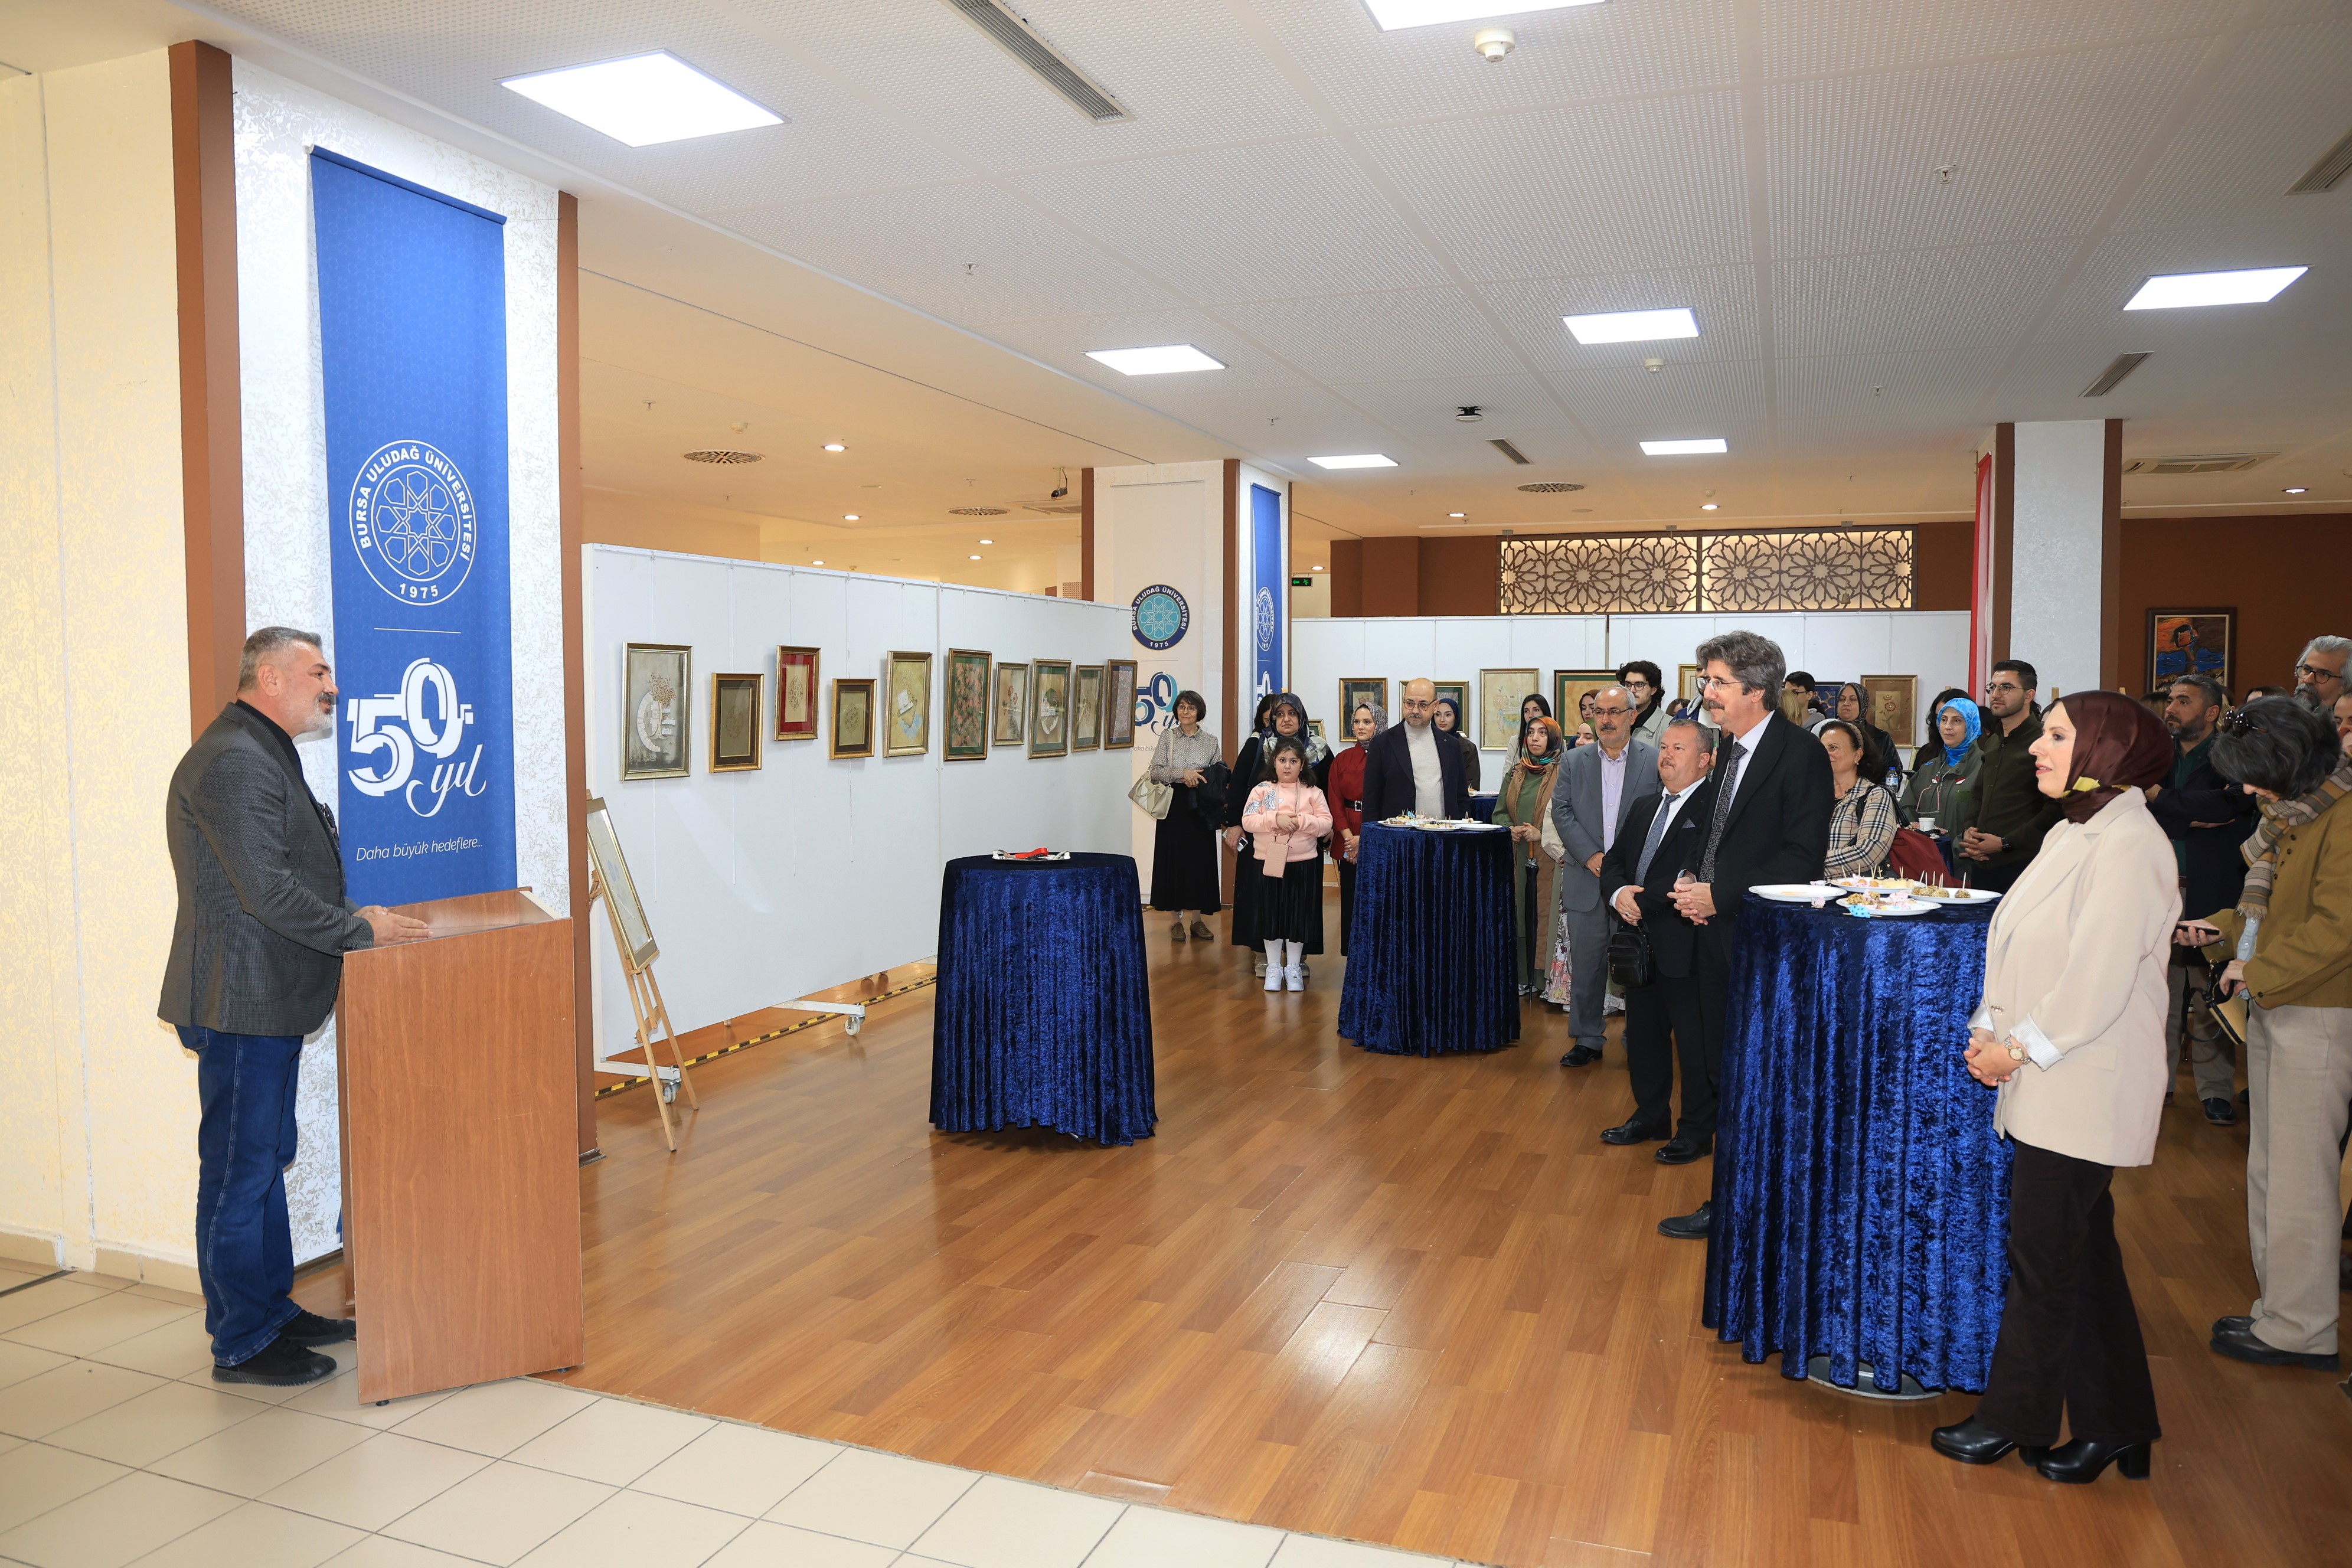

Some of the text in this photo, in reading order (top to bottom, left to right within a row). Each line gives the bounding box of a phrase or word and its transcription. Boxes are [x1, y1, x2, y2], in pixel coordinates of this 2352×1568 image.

[356, 445, 472, 561] BURSA ULUDAĞ ÜNİVERSİTESİ
[399, 583, 439, 599] 1975
[1135, 586, 1159, 604] ULUDAĞ
[1162, 586, 1188, 630] ÜNİVERSİTESİ
[406, 744, 486, 817] yıl
[357, 837, 483, 861] Daha büyük hedeflere...
